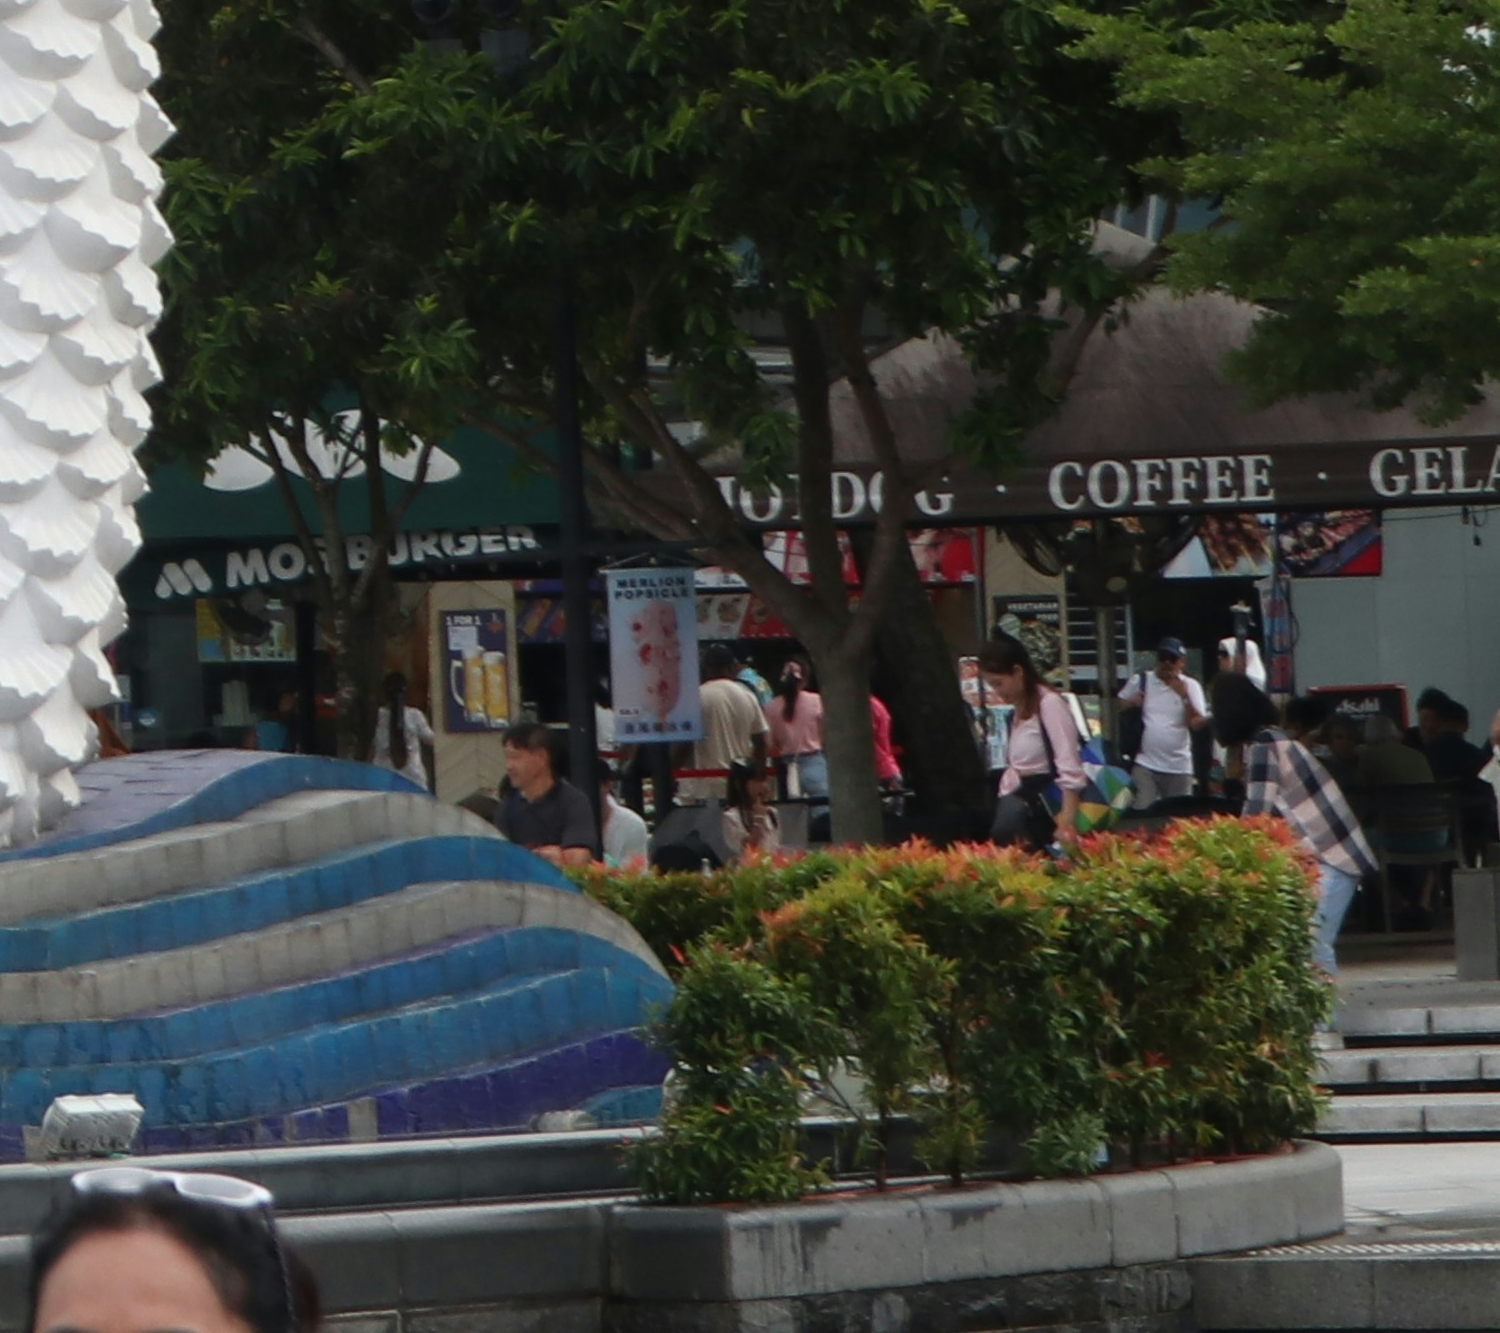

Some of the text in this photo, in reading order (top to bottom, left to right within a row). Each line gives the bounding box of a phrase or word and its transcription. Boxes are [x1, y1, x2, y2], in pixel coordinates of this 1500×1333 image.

[1048, 453, 1275, 511] COFFEE
[616, 576, 686, 589] MERLION
[614, 587, 688, 601] POPSICLE
